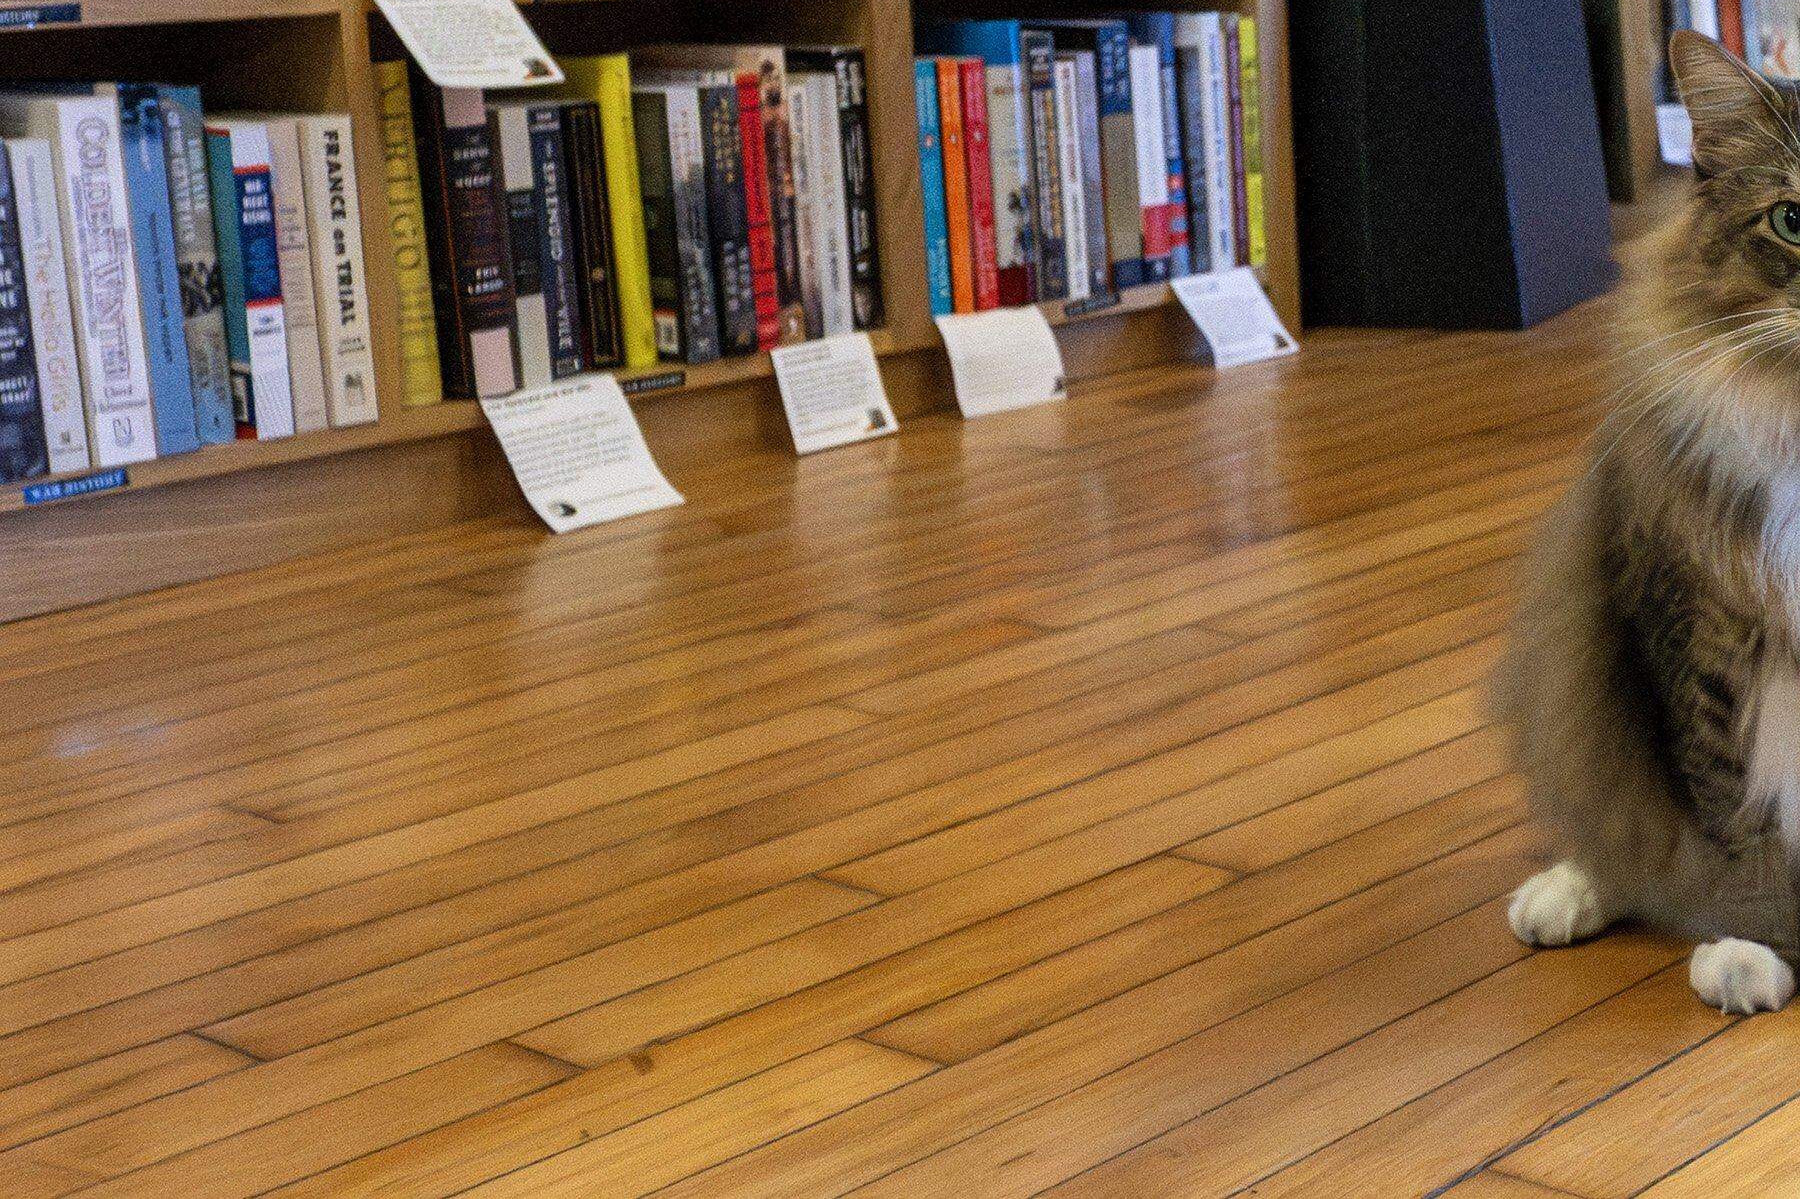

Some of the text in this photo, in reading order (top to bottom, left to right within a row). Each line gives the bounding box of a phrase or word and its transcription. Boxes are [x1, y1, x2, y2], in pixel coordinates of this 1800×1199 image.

[323, 129, 358, 327] FRANCE on TRIAL
[380, 82, 423, 273] VERTIGO
[541, 161, 565, 262] SPLENDID
[556, 305, 573, 349] VILE
[40, 287, 63, 352] Hello
